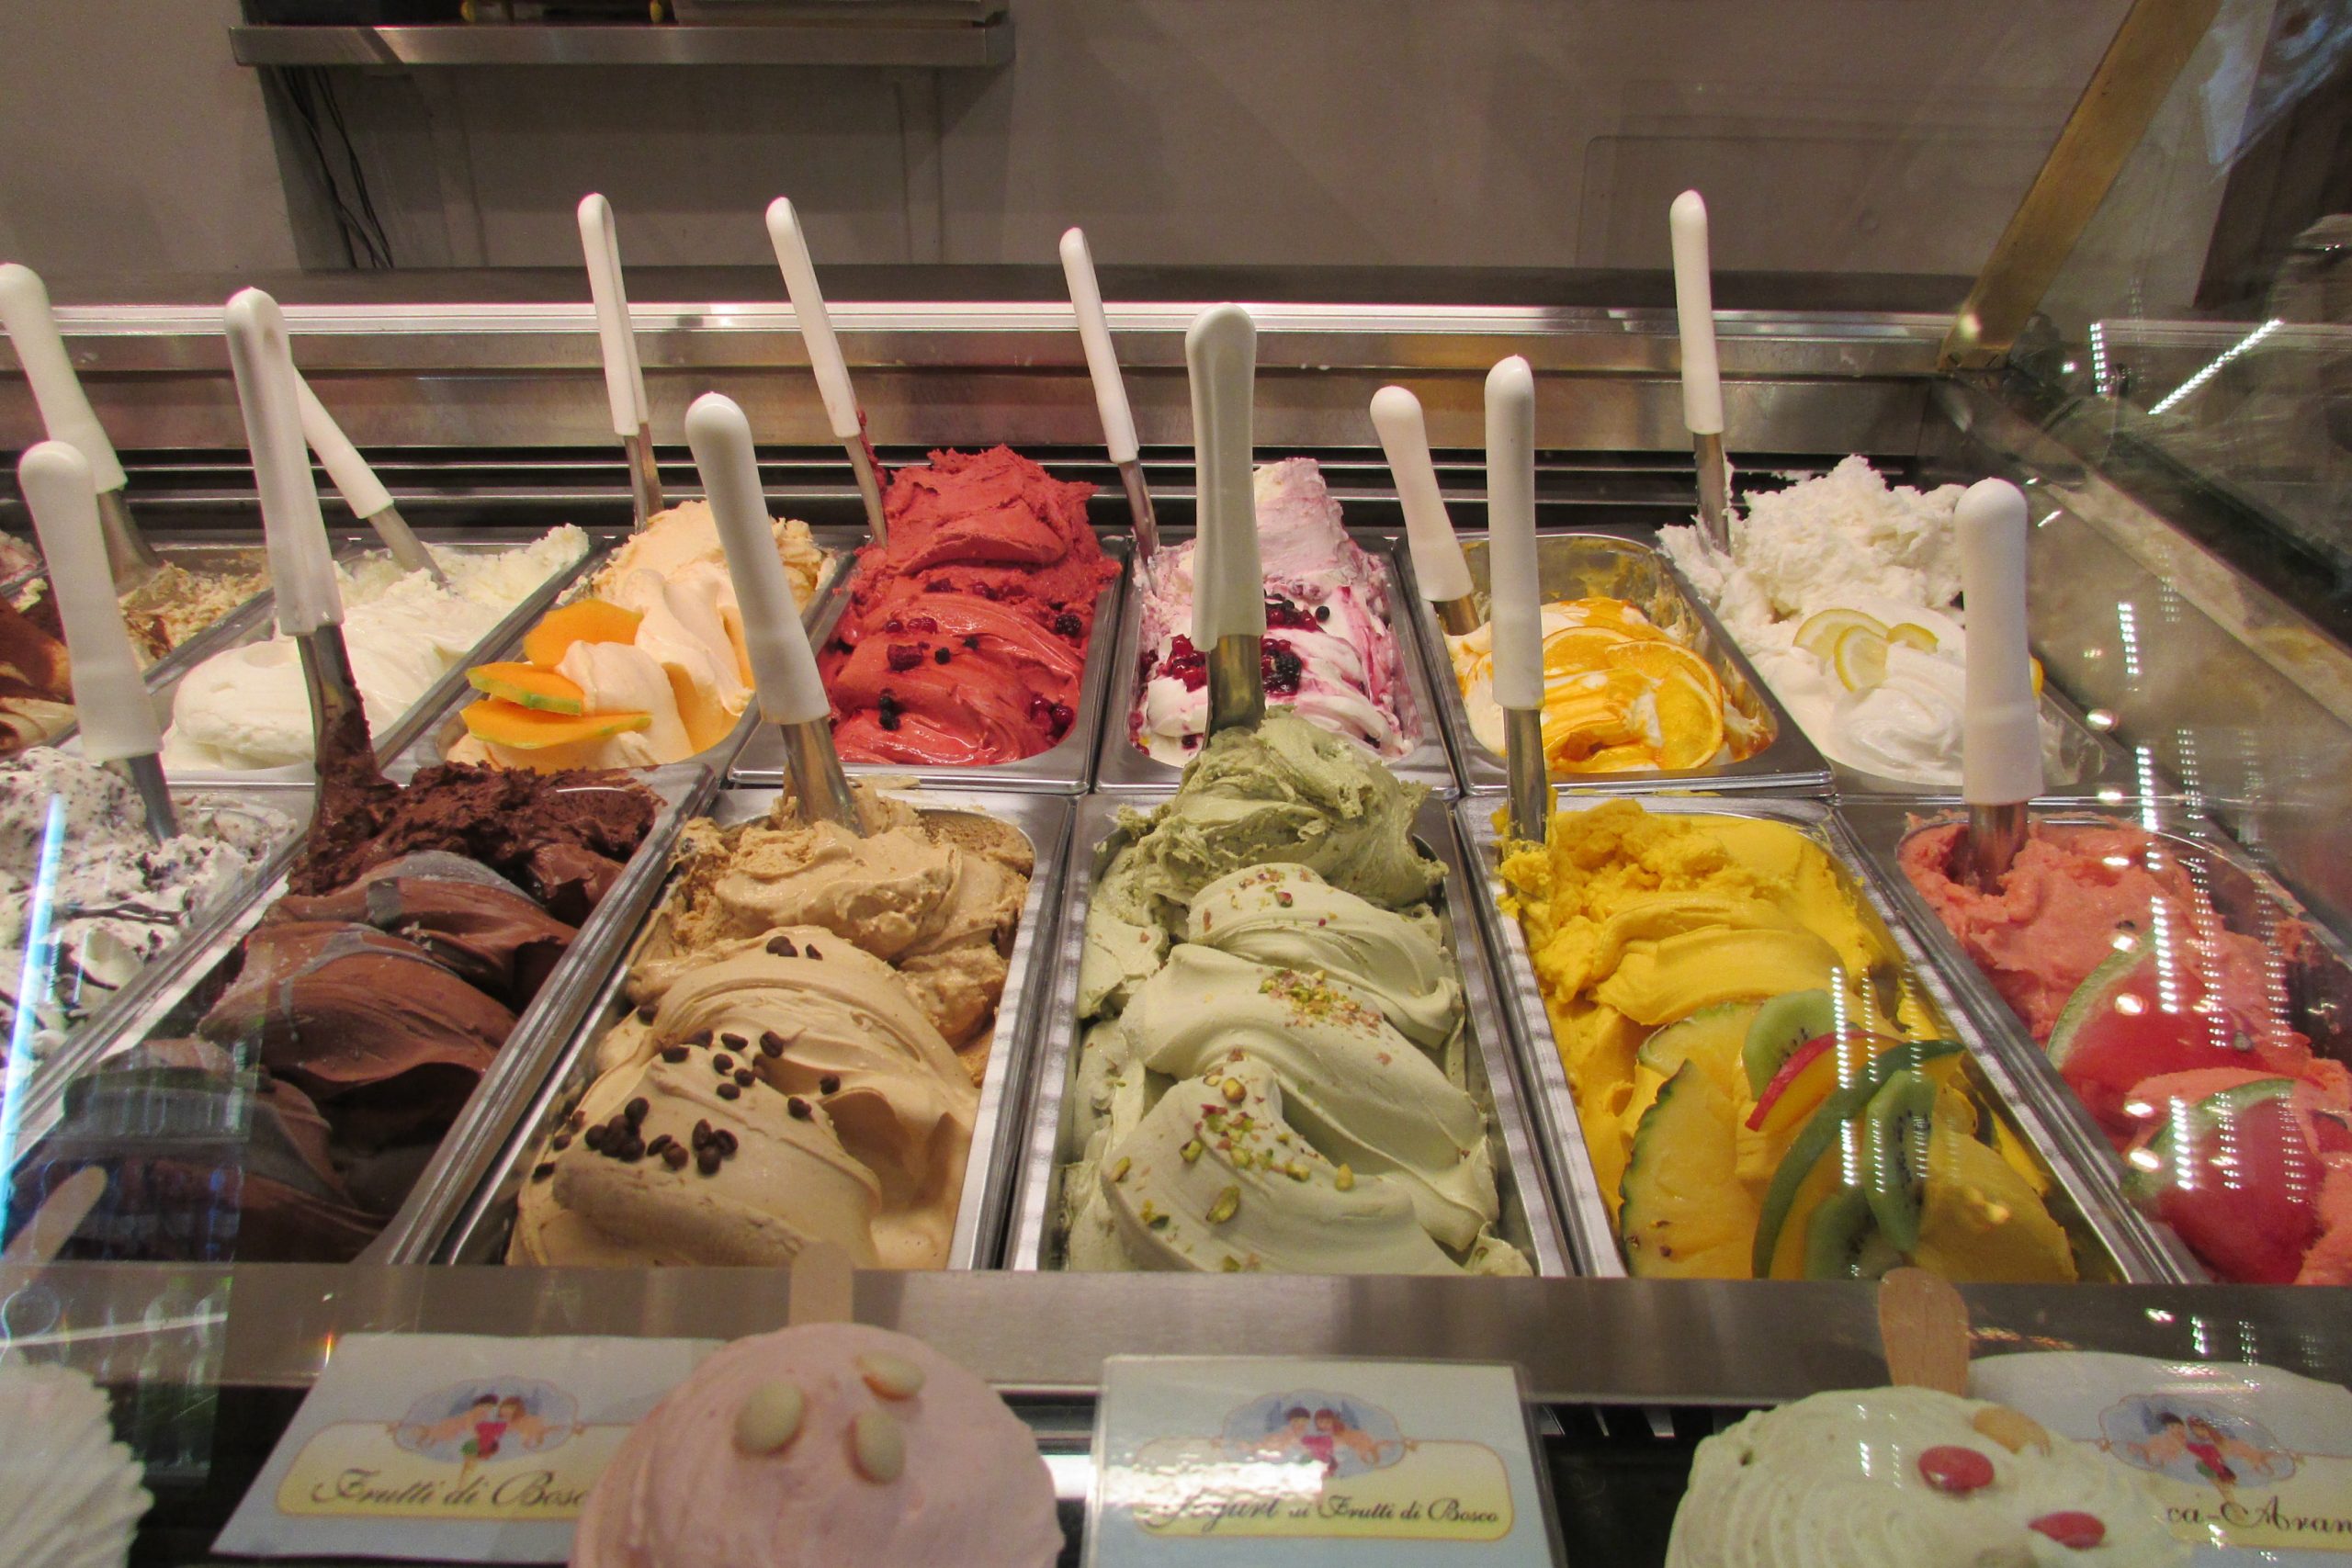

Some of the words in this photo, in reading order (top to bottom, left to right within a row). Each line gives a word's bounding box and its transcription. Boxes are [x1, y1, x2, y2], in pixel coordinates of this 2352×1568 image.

[311, 1468, 446, 1506] Frutti
[444, 1474, 490, 1506] di
[491, 1470, 590, 1506] Bosc
[1145, 1492, 1280, 1532] Ygurt
[1317, 1495, 1396, 1519] Frutti
[1399, 1501, 1423, 1519] di
[1428, 1496, 1498, 1522] Bosco
